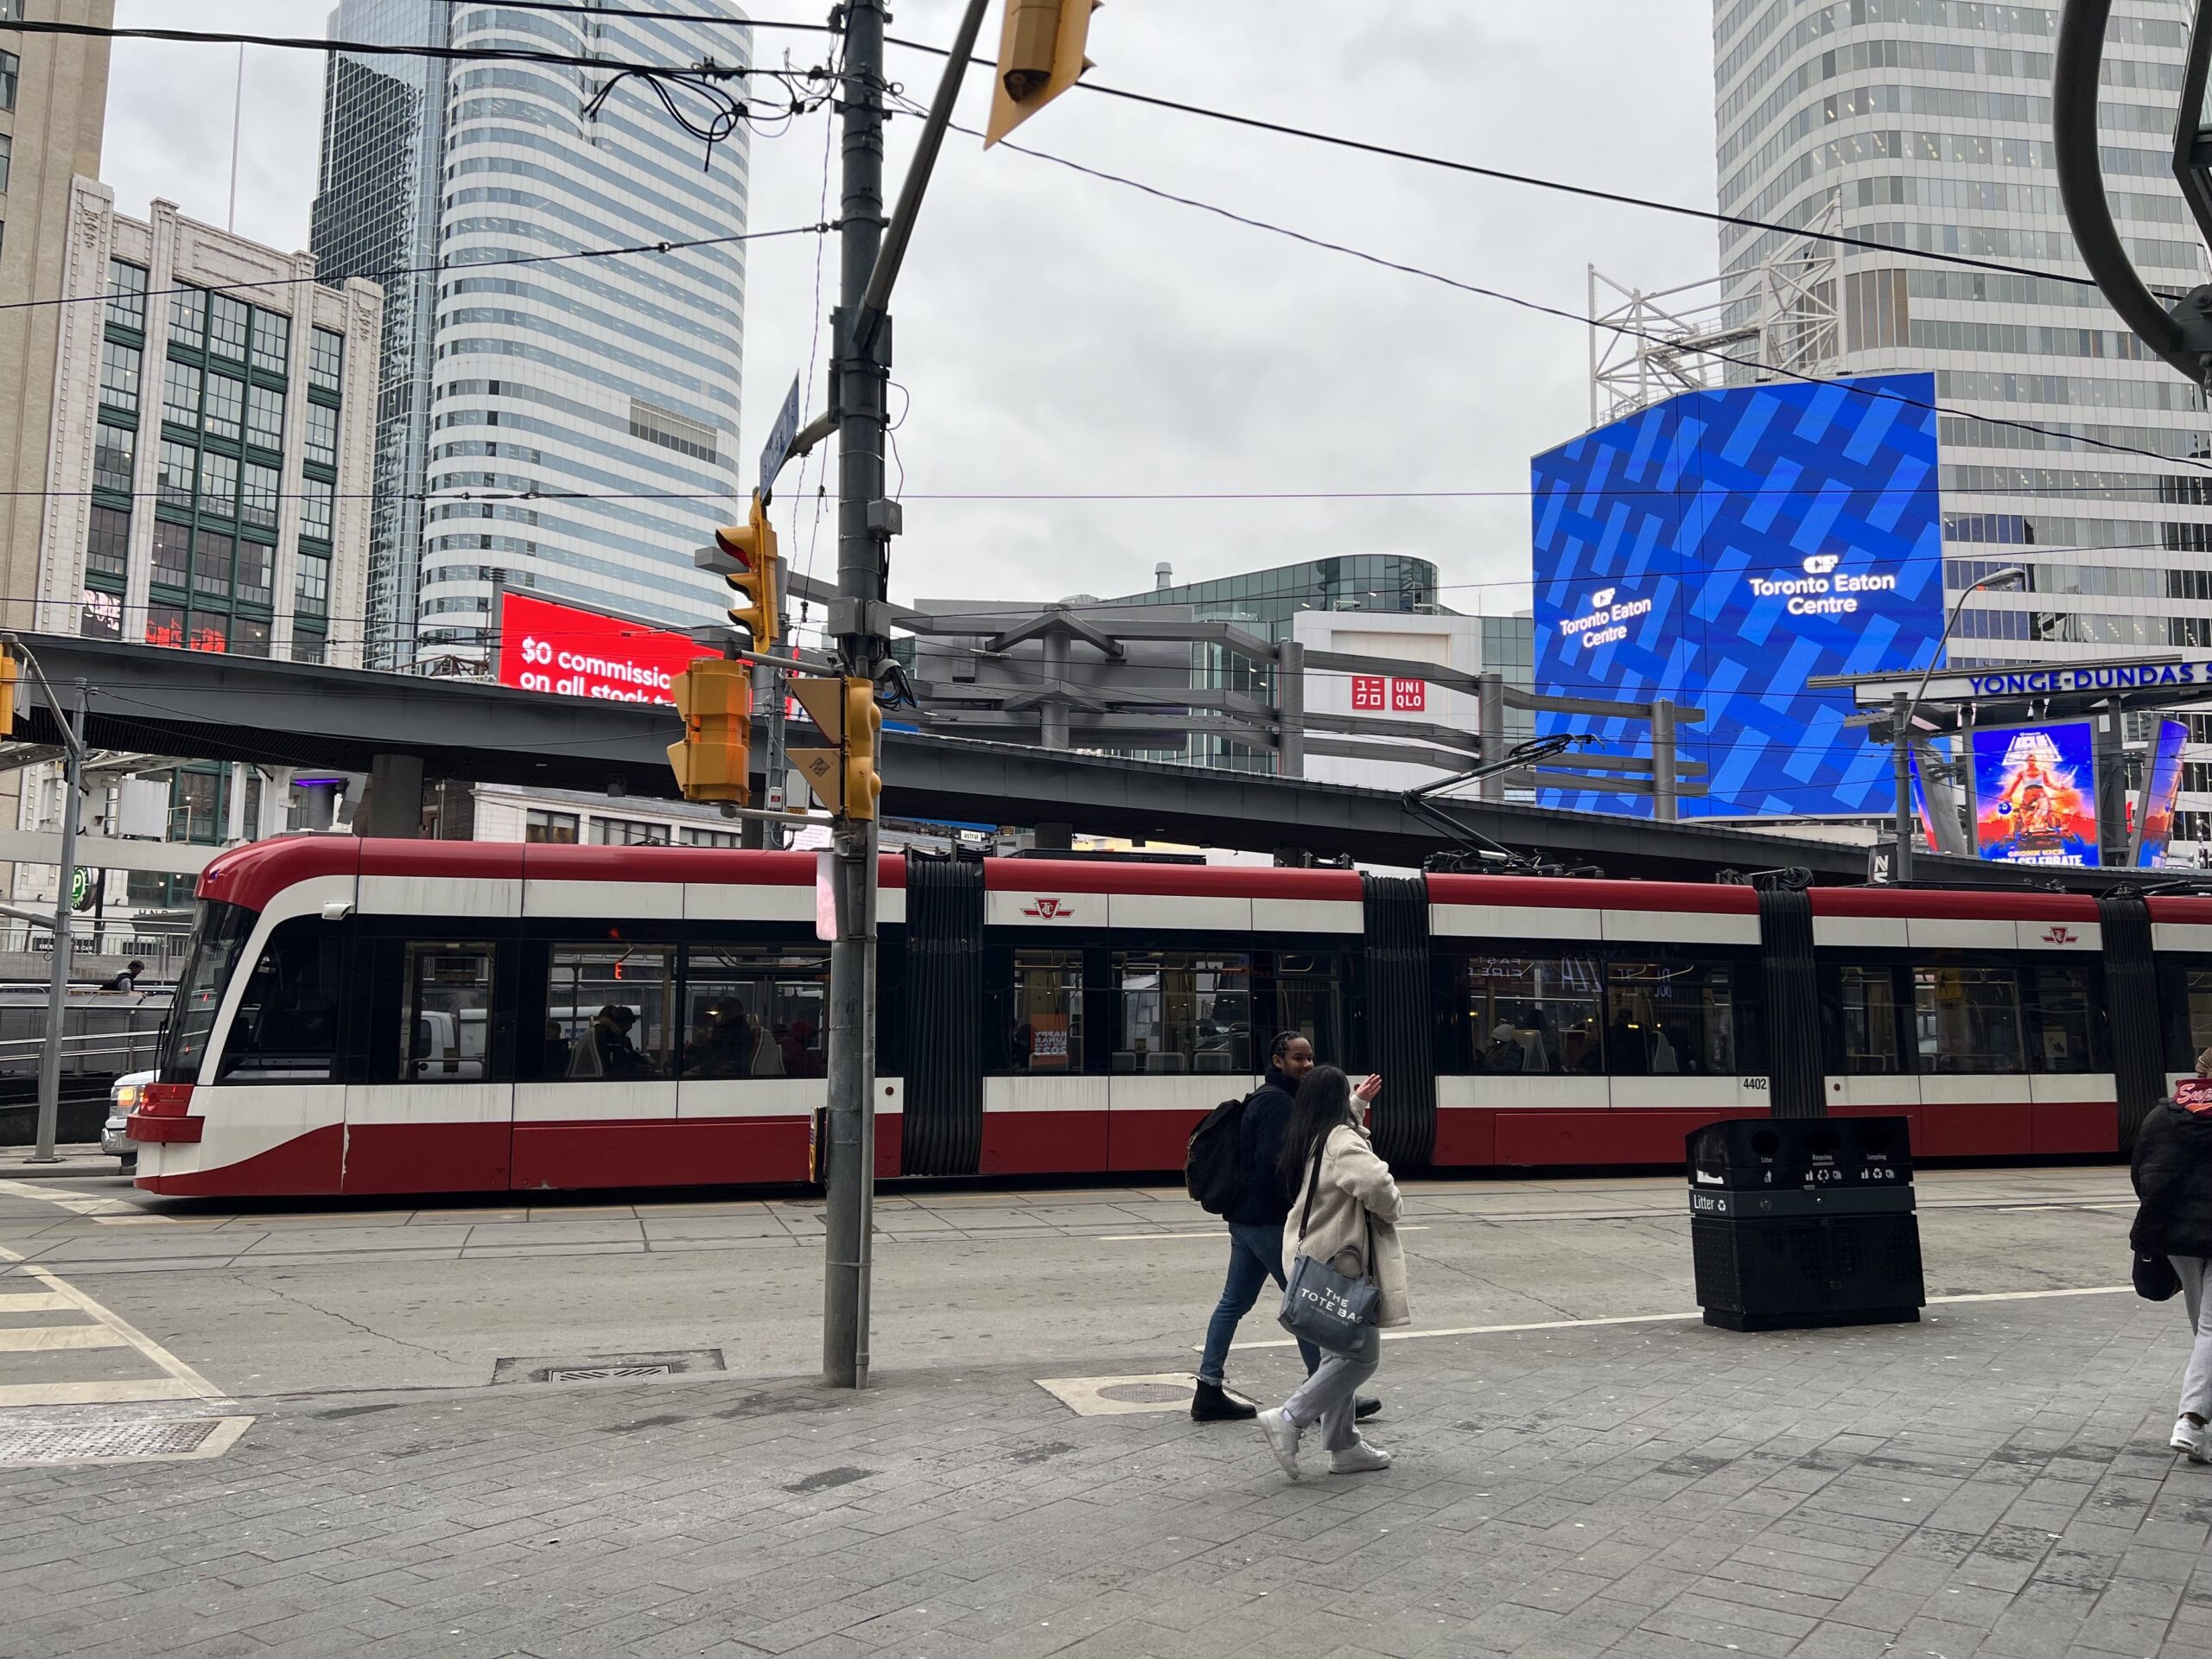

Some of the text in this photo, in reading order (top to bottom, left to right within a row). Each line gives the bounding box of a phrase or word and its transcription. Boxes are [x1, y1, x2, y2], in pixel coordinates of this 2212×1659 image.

[1803, 555, 1839, 574] CF
[1749, 574, 1896, 596] Toronto Eaton
[1592, 588, 1616, 608] CF
[1788, 597, 1858, 615] Centre
[1560, 599, 1652, 636] Toronto Eaton
[1583, 626, 1628, 648] Centre
[521, 636, 552, 665] $0
[519, 672, 550, 692] on
[556, 677, 585, 697] all
[1968, 664, 2194, 695] YONGE-DUNDAS
[1743, 1078, 1767, 1090] 4402
[1694, 1194, 1715, 1211] Litter
[1301, 1288, 1335, 1312] TOTE
[1325, 1287, 1349, 1307] THE
